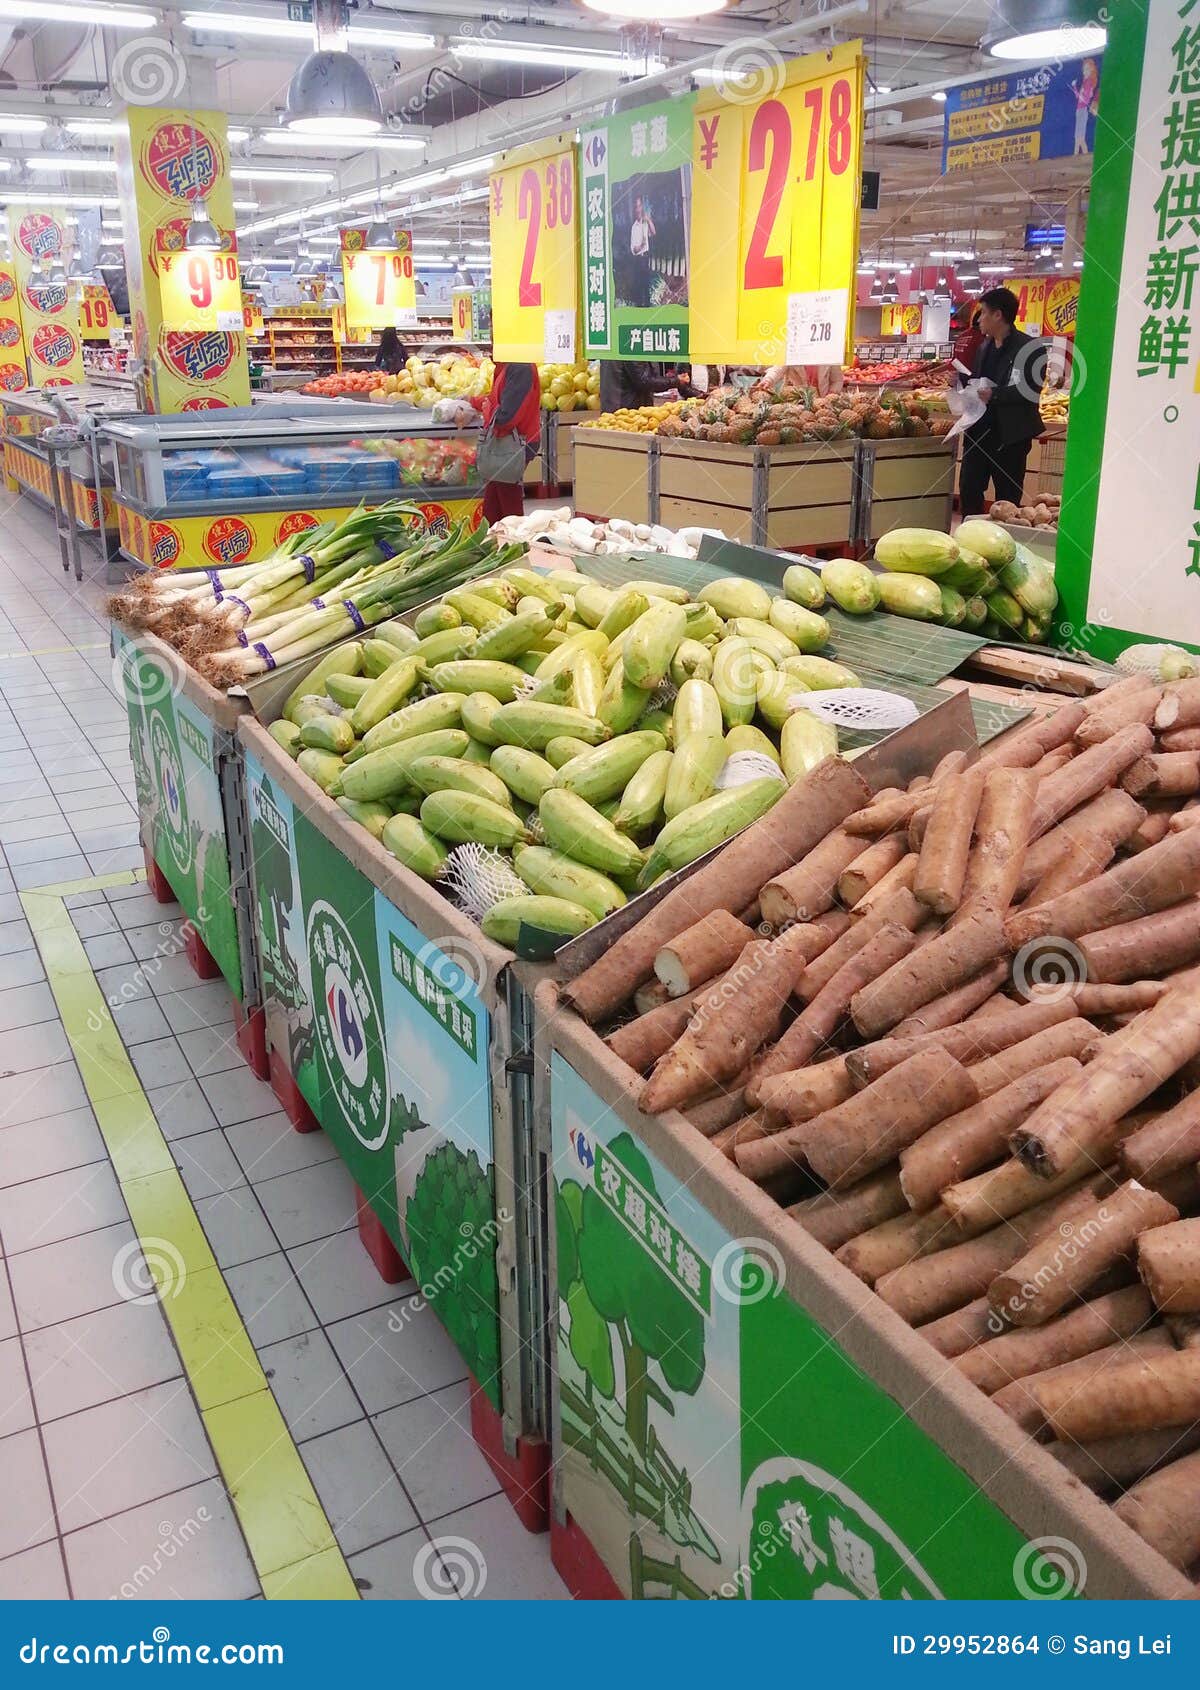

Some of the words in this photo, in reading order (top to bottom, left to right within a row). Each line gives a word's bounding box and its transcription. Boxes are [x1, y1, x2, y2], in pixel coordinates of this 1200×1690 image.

[588, 187, 606, 333] 农超对接
[1137, 0, 1200, 423] 您提供新鲜。
[630, 328, 680, 352] 产自山东
[810, 323, 832, 342] 2.78
[600, 1157, 701, 1297] 农超对接
